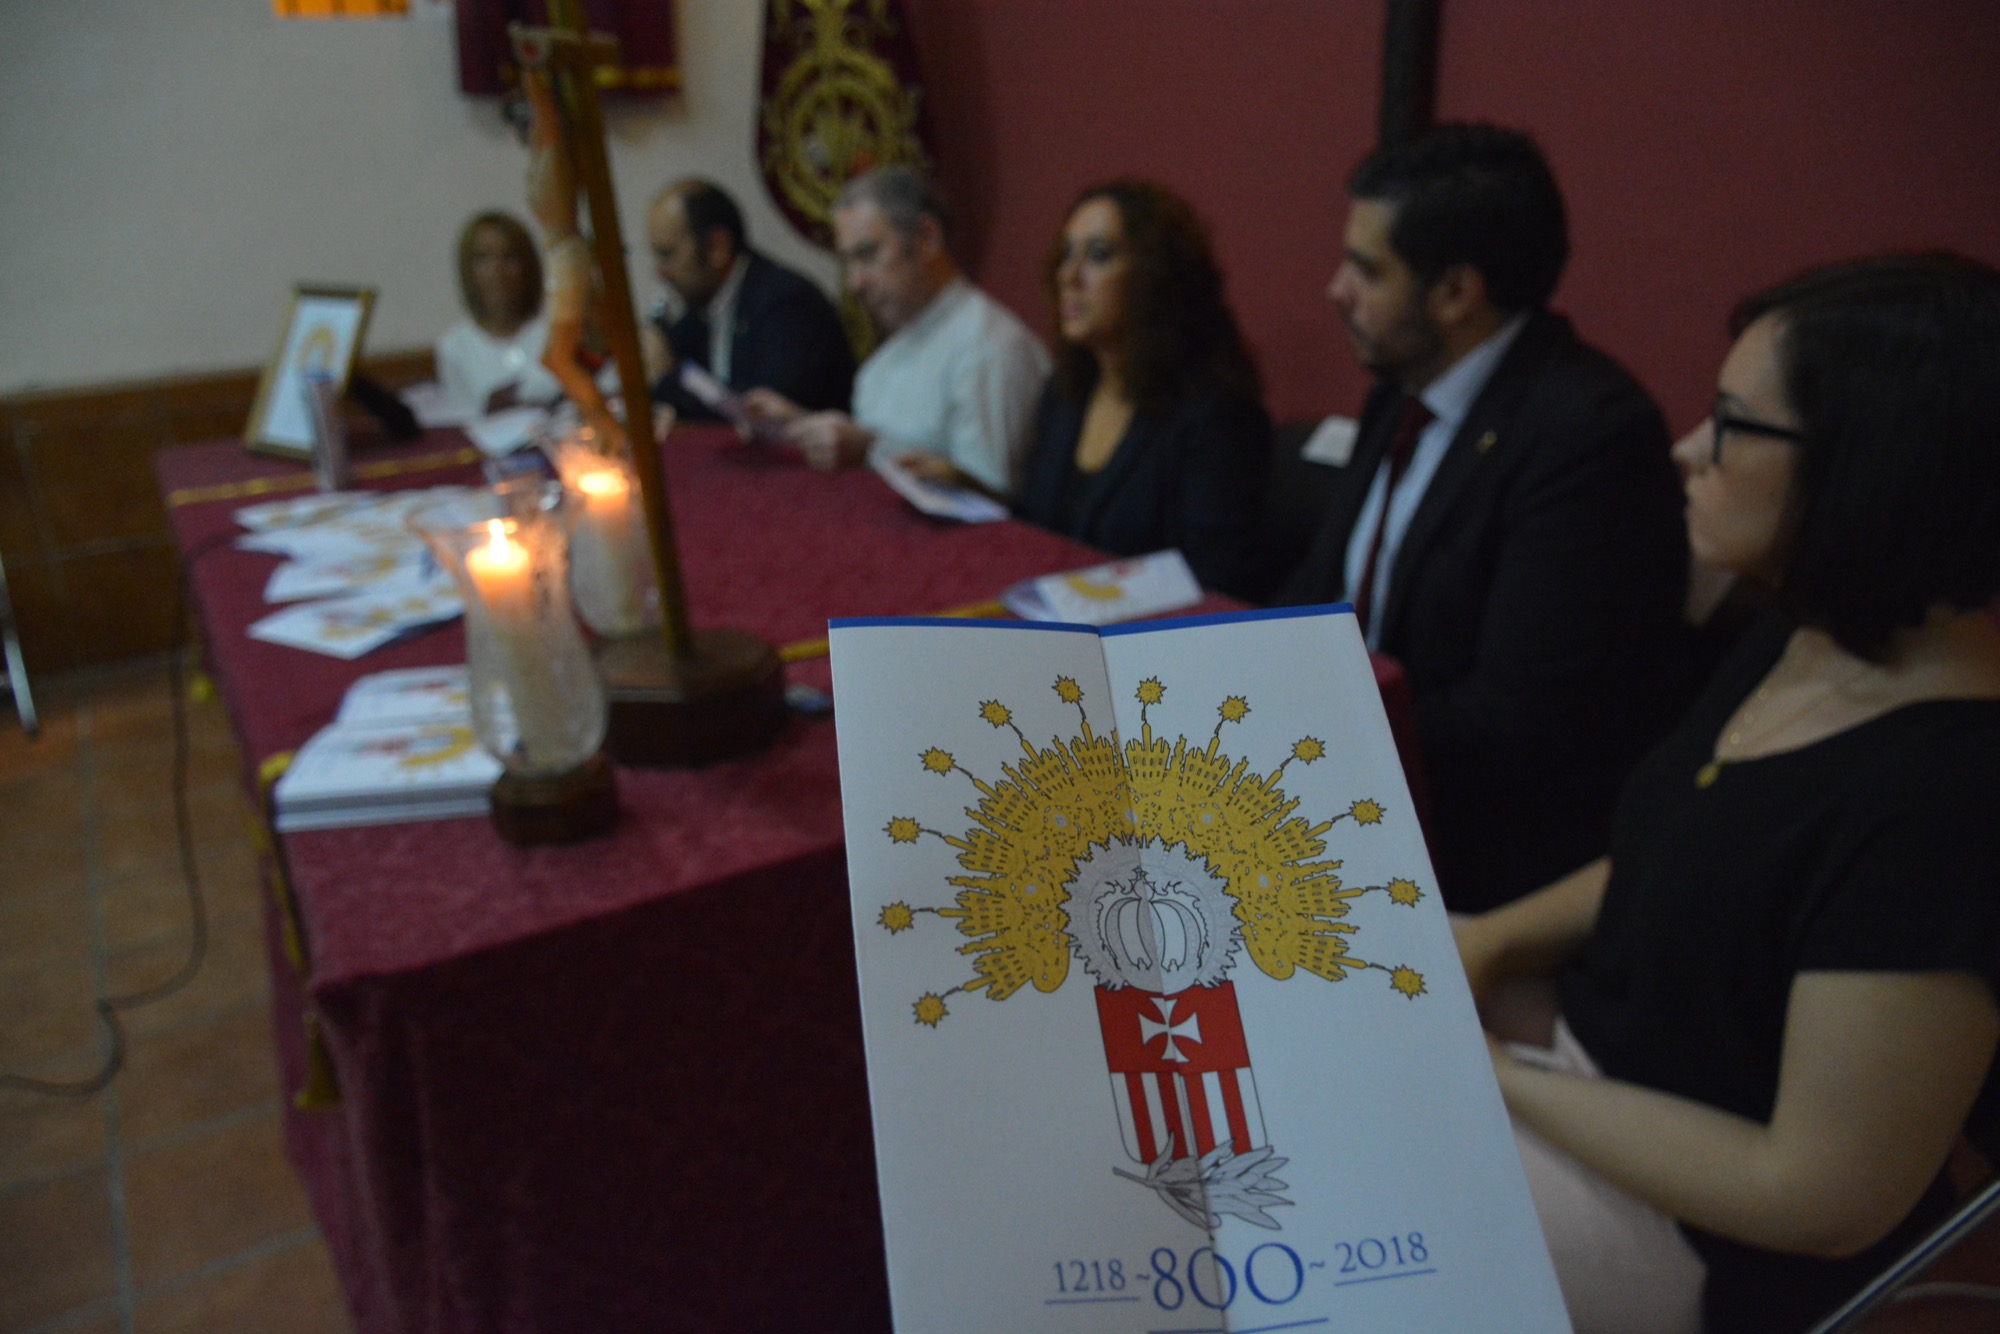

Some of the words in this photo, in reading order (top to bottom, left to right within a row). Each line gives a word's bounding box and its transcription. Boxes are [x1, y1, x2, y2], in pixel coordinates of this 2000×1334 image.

[1053, 1260, 1126, 1293] 1218
[1150, 1241, 1305, 1311] 800
[1335, 1231, 1429, 1274] 2018
